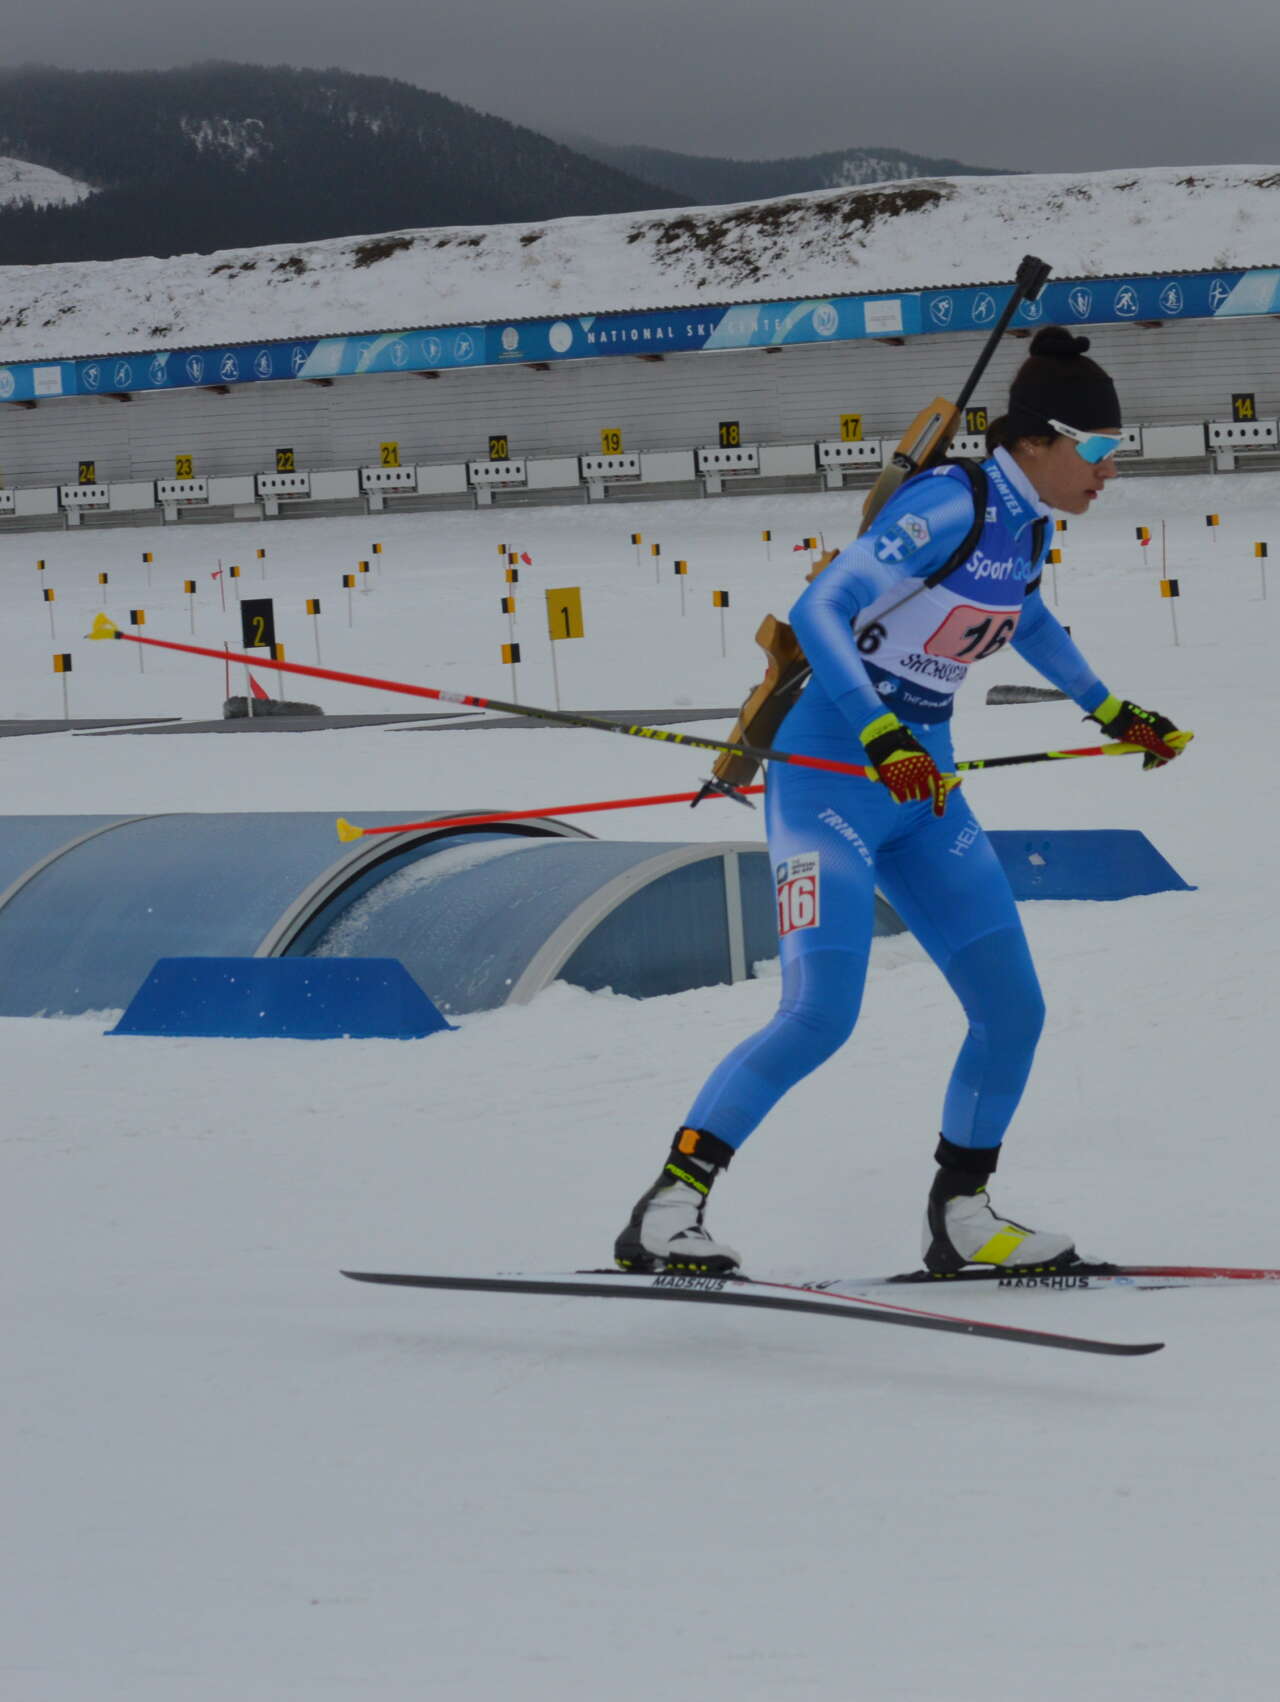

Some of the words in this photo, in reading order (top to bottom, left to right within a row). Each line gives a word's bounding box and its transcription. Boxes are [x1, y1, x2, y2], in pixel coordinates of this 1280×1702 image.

[587, 325, 675, 344] NATIONAL
[686, 322, 715, 337] SKI
[1234, 398, 1253, 419] 14
[842, 418, 860, 437] 17
[966, 411, 986, 432] 16
[602, 432, 620, 452] 19
[720, 425, 738, 445] 18
[381, 446, 398, 465] 21
[489, 440, 506, 459] 20
[176, 458, 192, 477] 23
[276, 452, 293, 471] 22
[79, 465, 95, 483] 24
[985, 465, 1023, 516] TRIMTEX
[966, 550, 1032, 580] SportQo
[252, 616, 266, 647] 2
[560, 606, 571, 638] 1
[958, 616, 1015, 661] 16
[817, 808, 874, 867] TRIMTEX
[949, 816, 983, 857] HELL
[778, 879, 814, 931] 16
[652, 1275, 729, 1291] MADSHUS
[998, 1276, 1089, 1289] MADSHUS
